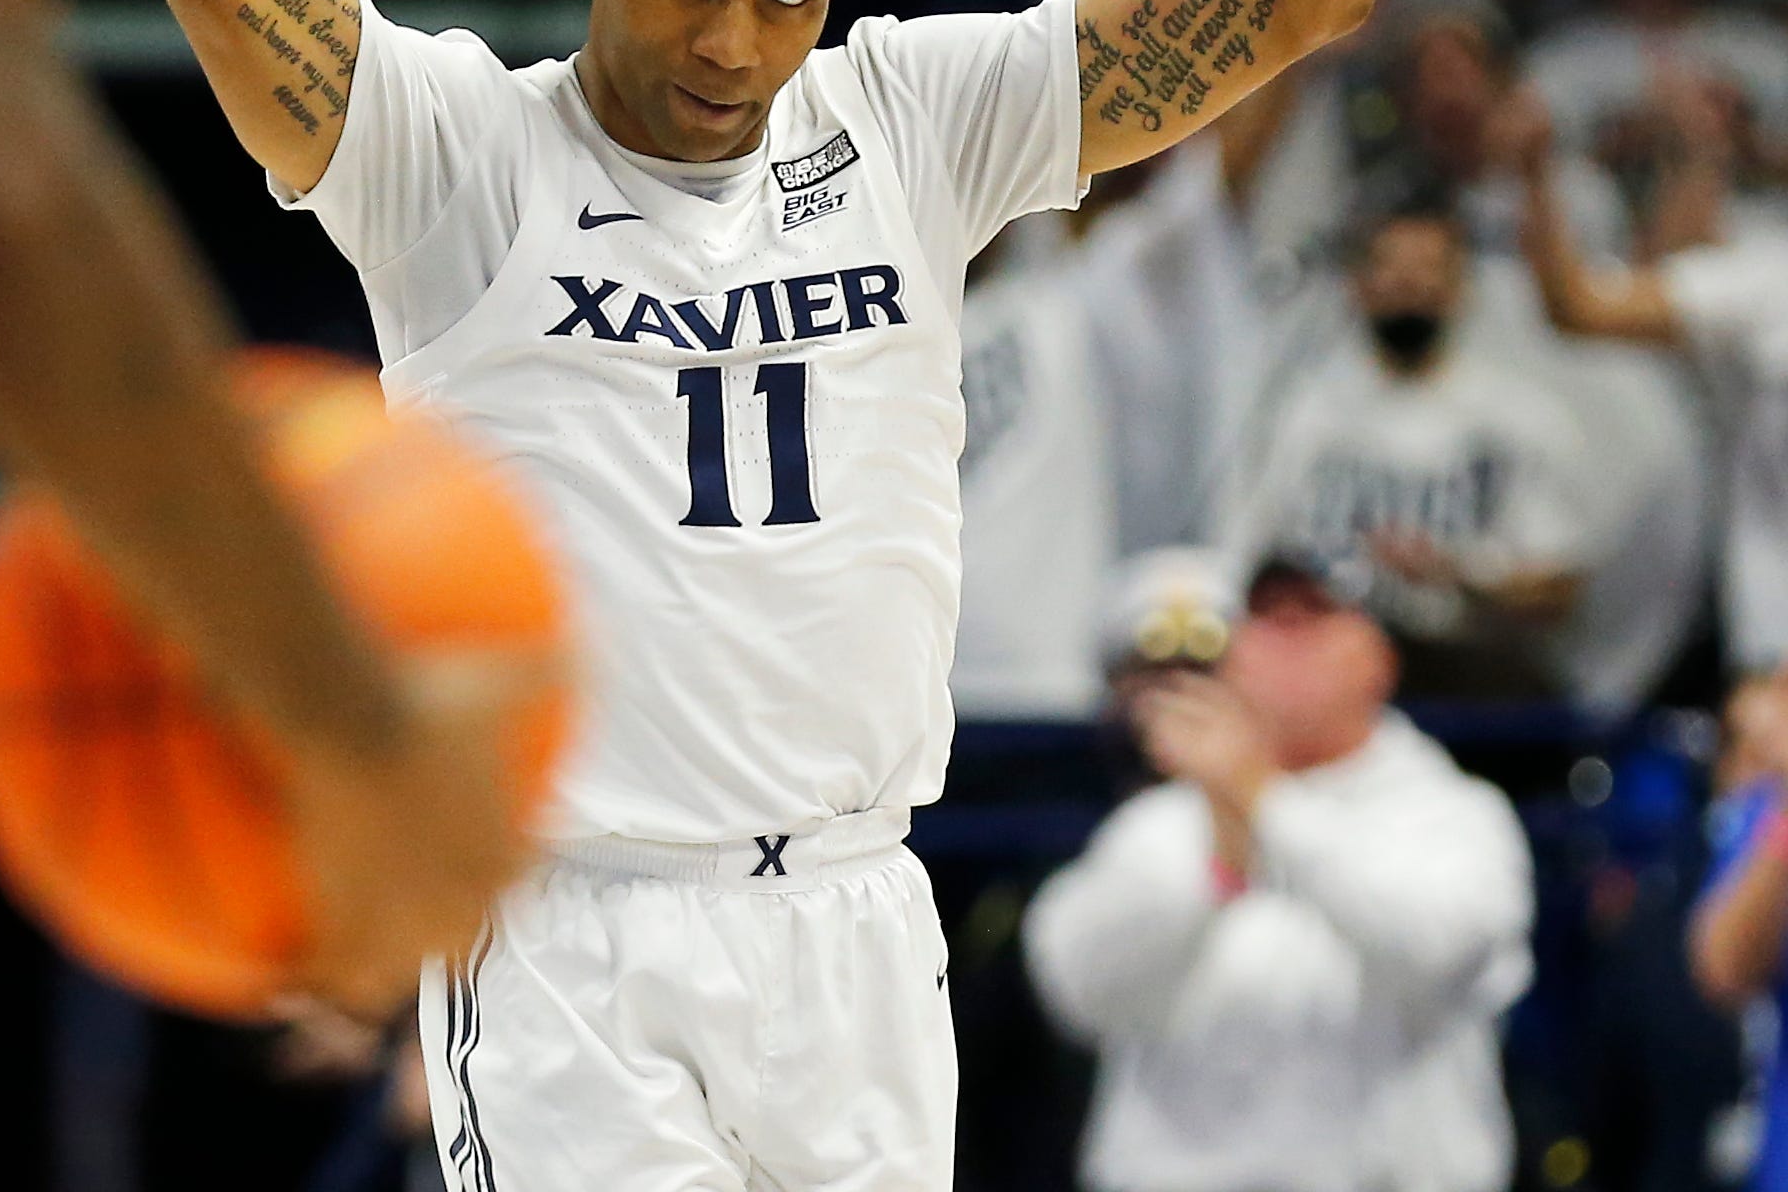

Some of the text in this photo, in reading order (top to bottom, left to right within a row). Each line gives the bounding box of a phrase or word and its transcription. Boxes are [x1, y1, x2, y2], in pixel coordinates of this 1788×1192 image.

[308, 17, 355, 76] streng
[1180, 72, 1211, 115] sell
[1213, 32, 1254, 74] my
[1100, 85, 1134, 124] me
[1122, 31, 1170, 97] fall
[1155, 48, 1193, 102] will
[781, 146, 855, 189] CHANGE
[783, 192, 847, 225] EAST
[784, 185, 829, 211] BIG
[544, 264, 909, 351] XAVIER
[676, 361, 821, 527] 11
[750, 835, 791, 876] X
